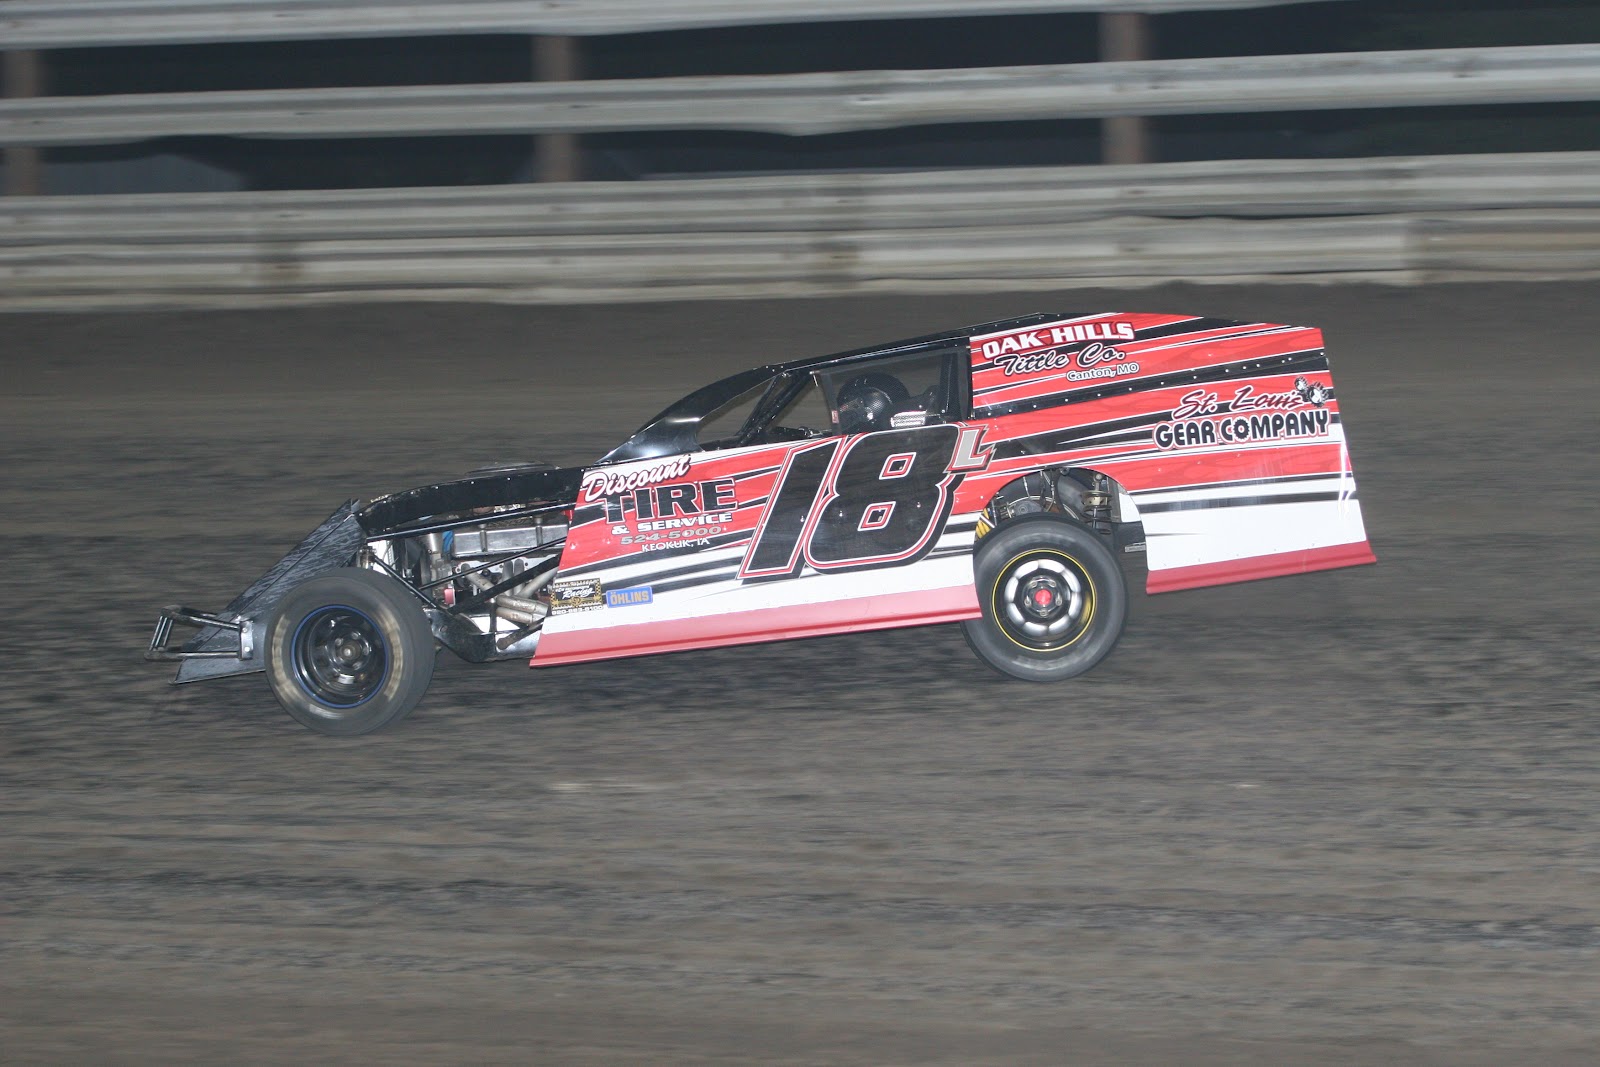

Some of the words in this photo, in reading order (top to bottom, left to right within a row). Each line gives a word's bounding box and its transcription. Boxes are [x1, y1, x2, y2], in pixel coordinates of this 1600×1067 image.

[982, 332, 1043, 359] OAK
[1051, 323, 1135, 344] HILLS
[995, 351, 1069, 375] Tittle
[1077, 343, 1125, 366] Co.
[1066, 366, 1116, 381] Canton,
[1116, 362, 1140, 375] MO
[1173, 390, 1217, 419] St.
[1229, 385, 1305, 412] Louis
[1155, 419, 1217, 449] GEAR
[1220, 409, 1330, 443] COMPANY
[582, 454, 691, 502] Discount
[601, 478, 738, 523] TIRE
[737, 424, 964, 580] 18
[611, 524, 630, 535] &
[637, 512, 733, 533] SERVICE
[620, 526, 722, 545] 524-5000
[641, 541, 694, 552] KEOKUK,
[696, 538, 711, 546] IA
[562, 587, 596, 600] Racing
[610, 590, 650, 605] ÖHLINS
